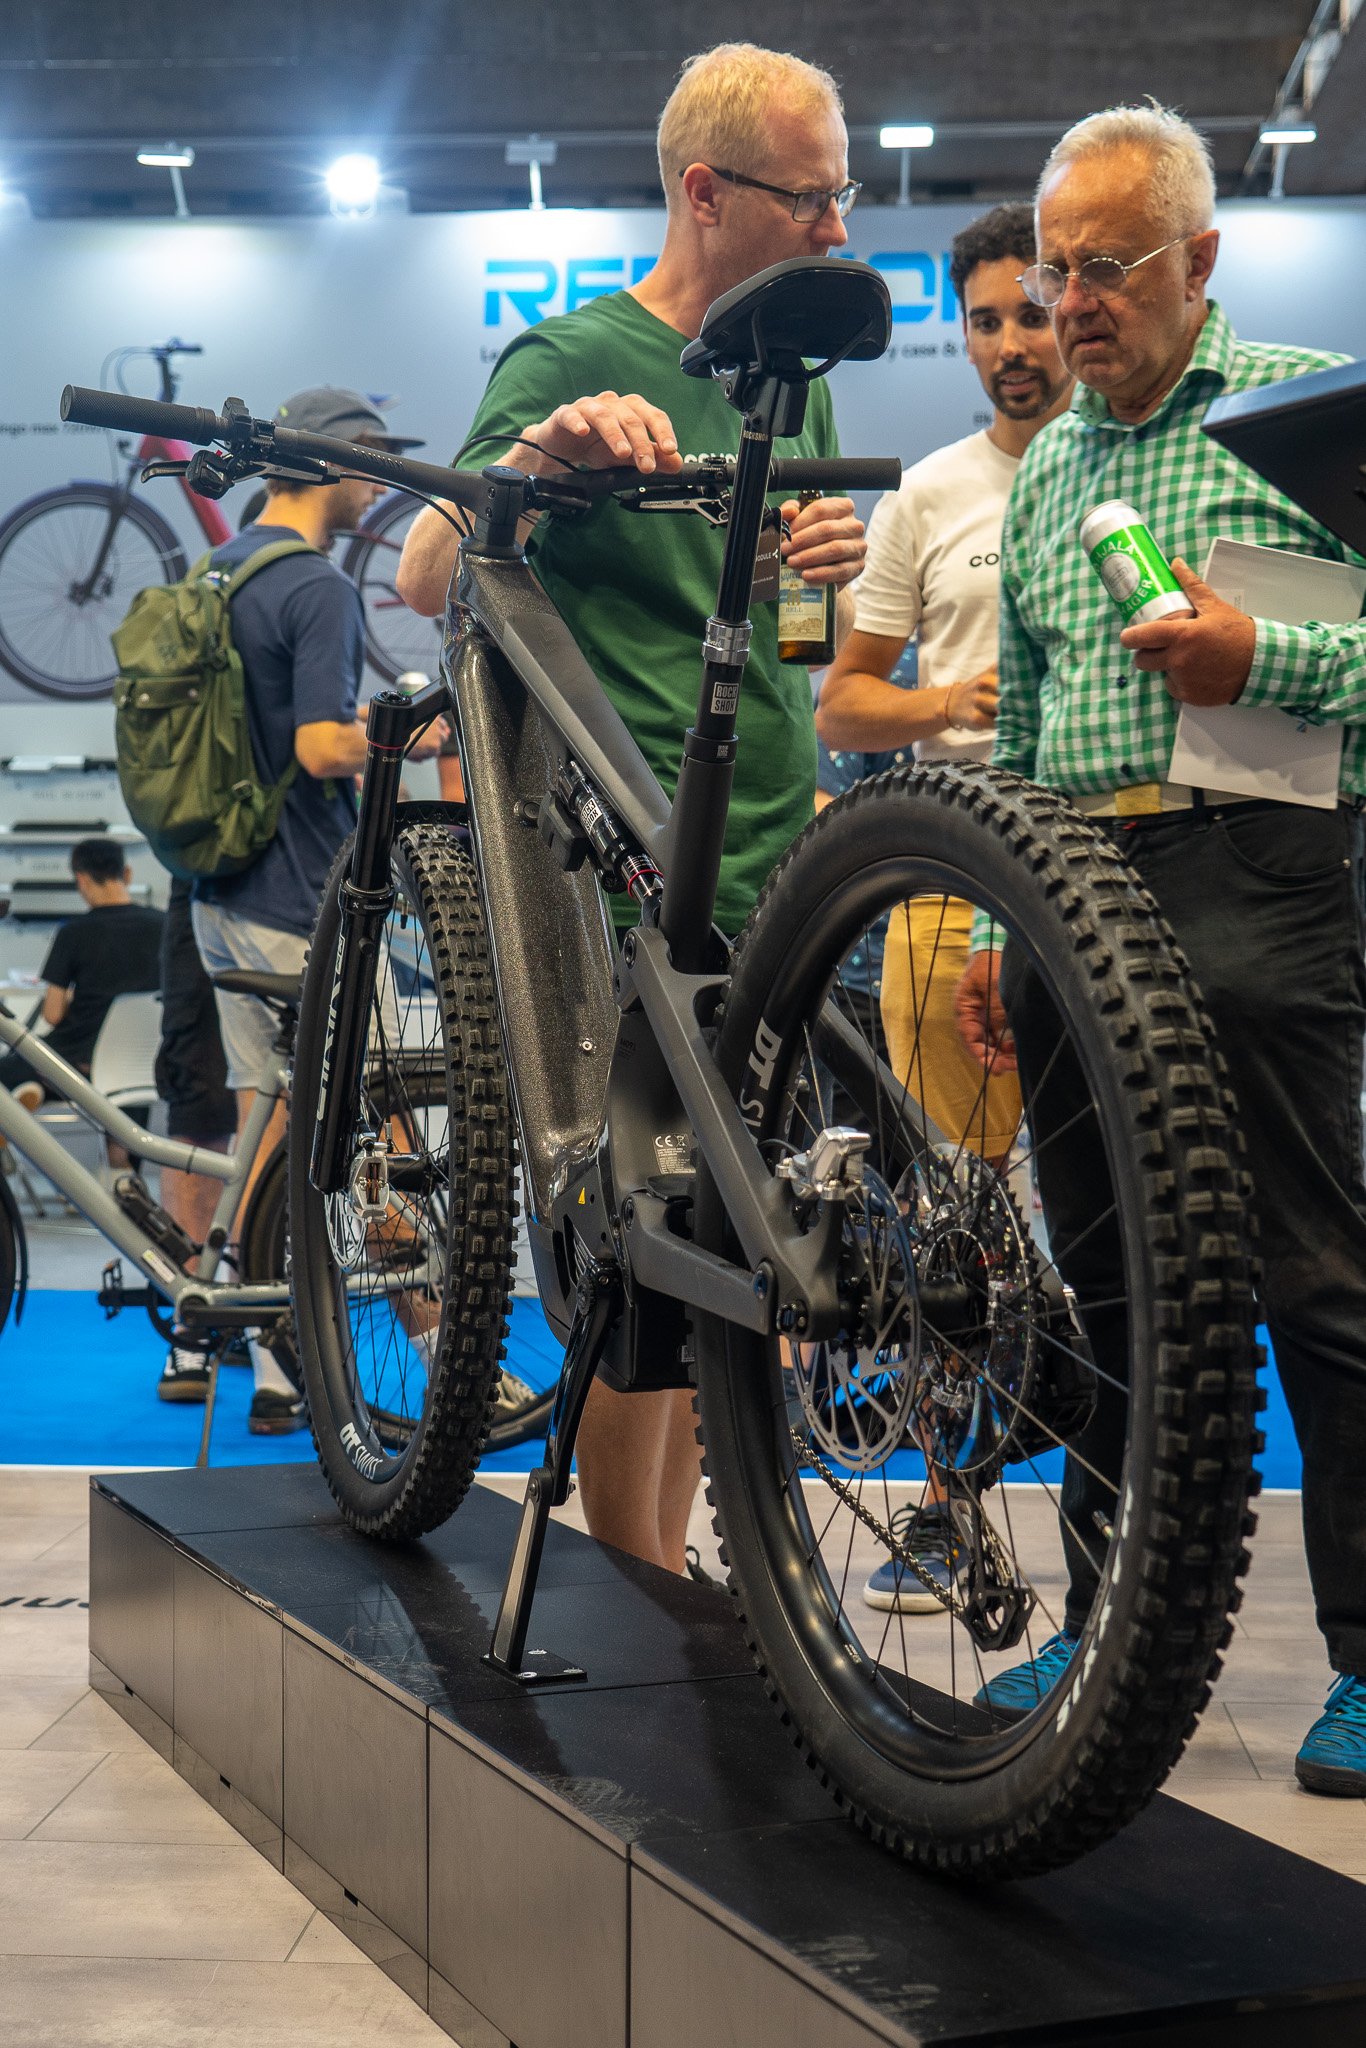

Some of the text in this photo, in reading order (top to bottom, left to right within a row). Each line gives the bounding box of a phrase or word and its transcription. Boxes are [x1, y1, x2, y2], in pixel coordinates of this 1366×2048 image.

[716, 684, 738, 699] ROCK
[714, 700, 736, 712] SHOX
[340, 1421, 384, 1480] DT SWISS
